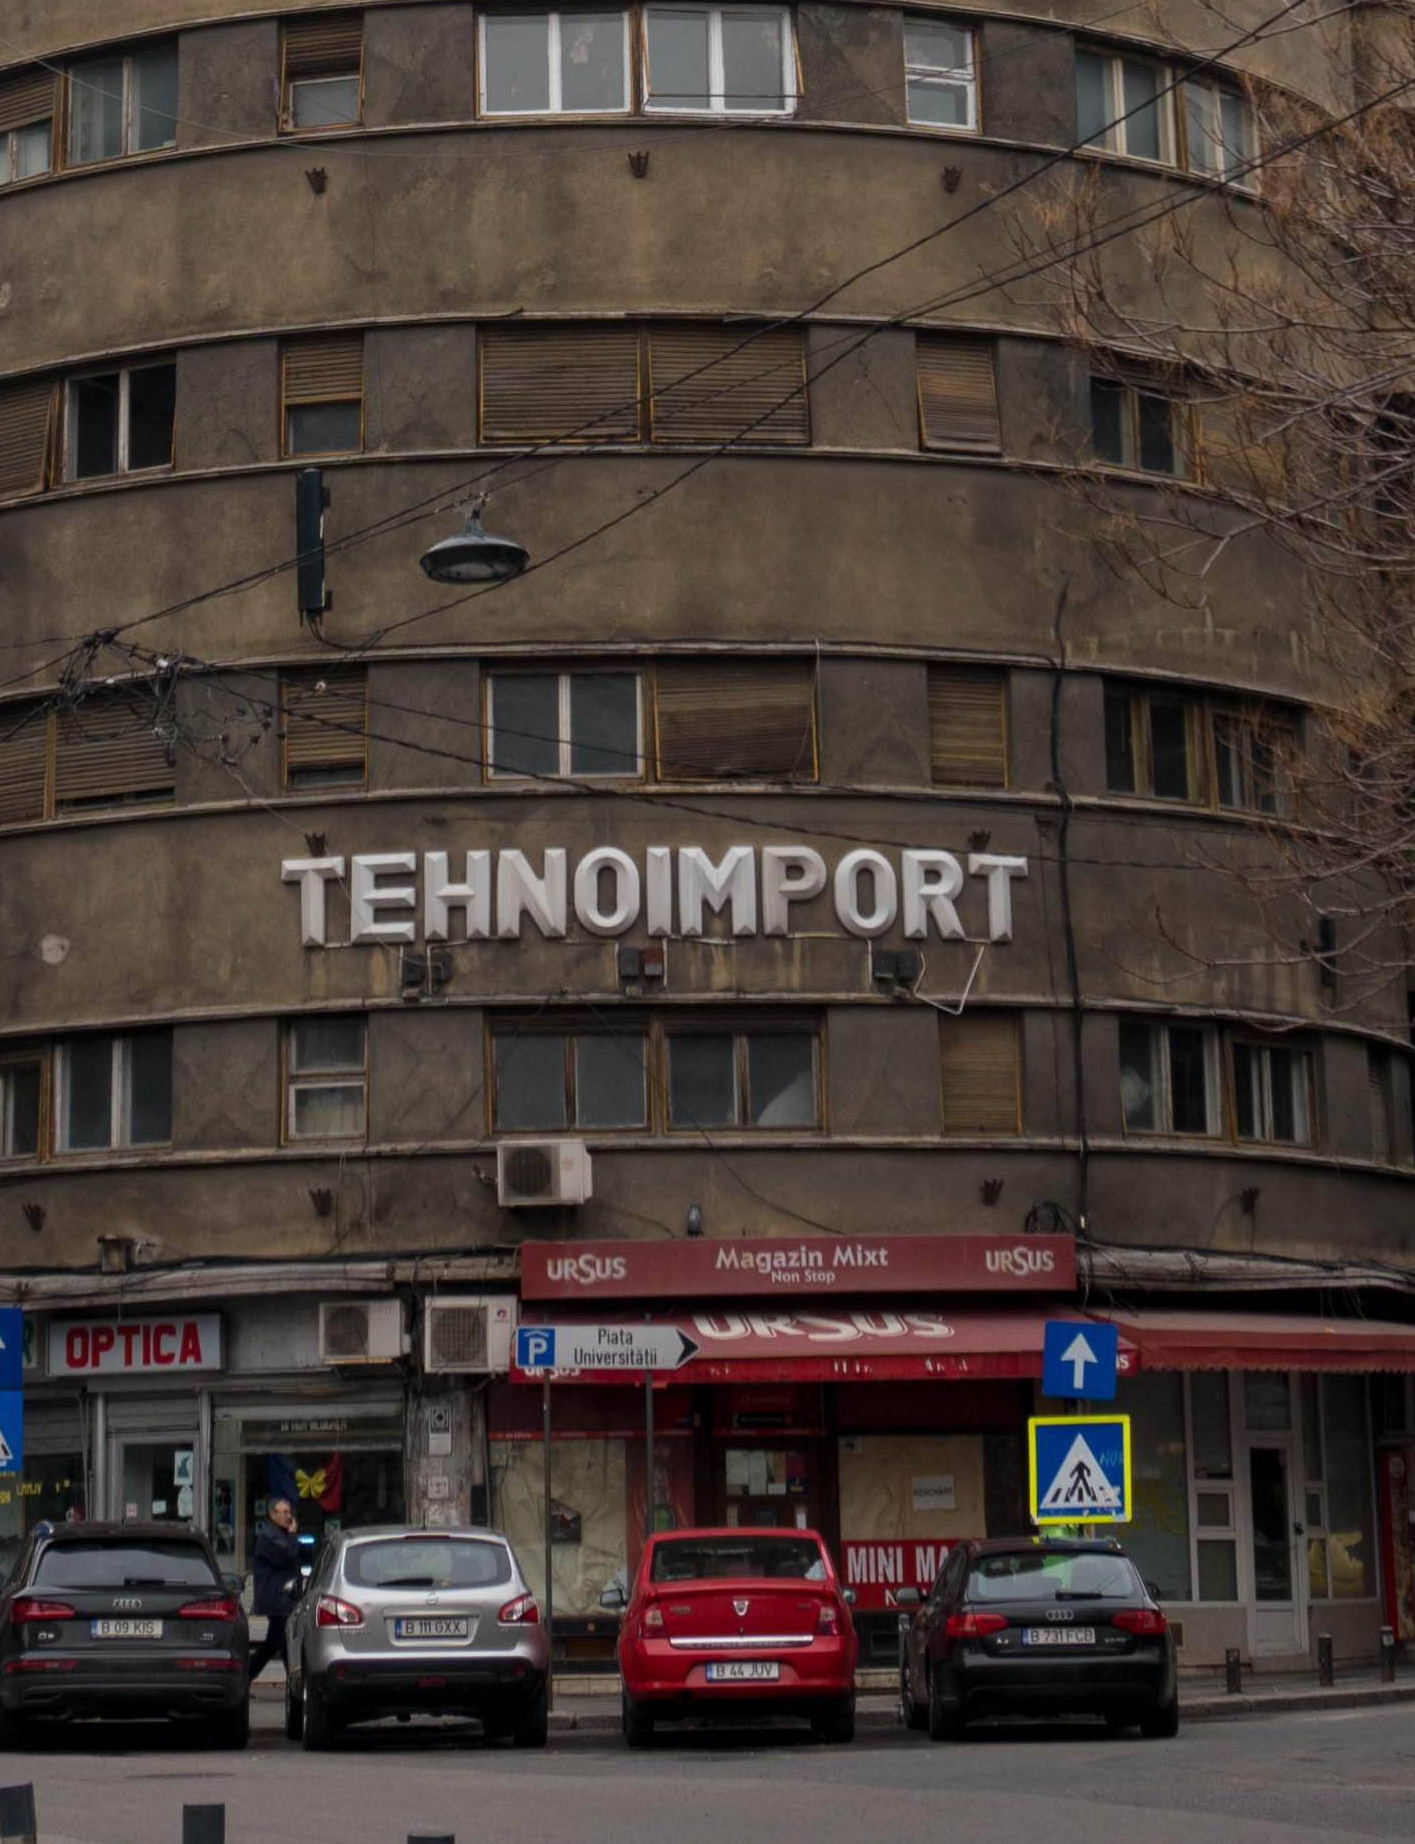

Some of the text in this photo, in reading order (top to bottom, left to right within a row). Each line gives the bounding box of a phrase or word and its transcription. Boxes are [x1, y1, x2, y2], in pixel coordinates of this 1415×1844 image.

[281, 846, 1028, 947] TEHNOIMPORT
[547, 1254, 627, 1284] URSUS
[715, 1245, 889, 1273] Magazin Mixt
[986, 1246, 1054, 1275] URSUS
[771, 1269, 835, 1284] Non Stop
[65, 1322, 203, 1369] OPTICA
[528, 1338, 547, 1364] P
[847, 1545, 950, 1584] MINI MA
[101, 1620, 154, 1634] B 09 KIS
[405, 1622, 462, 1634] B 111 GXX
[1031, 1630, 1039, 1642] B
[716, 1663, 773, 1677] B 44 JUV
